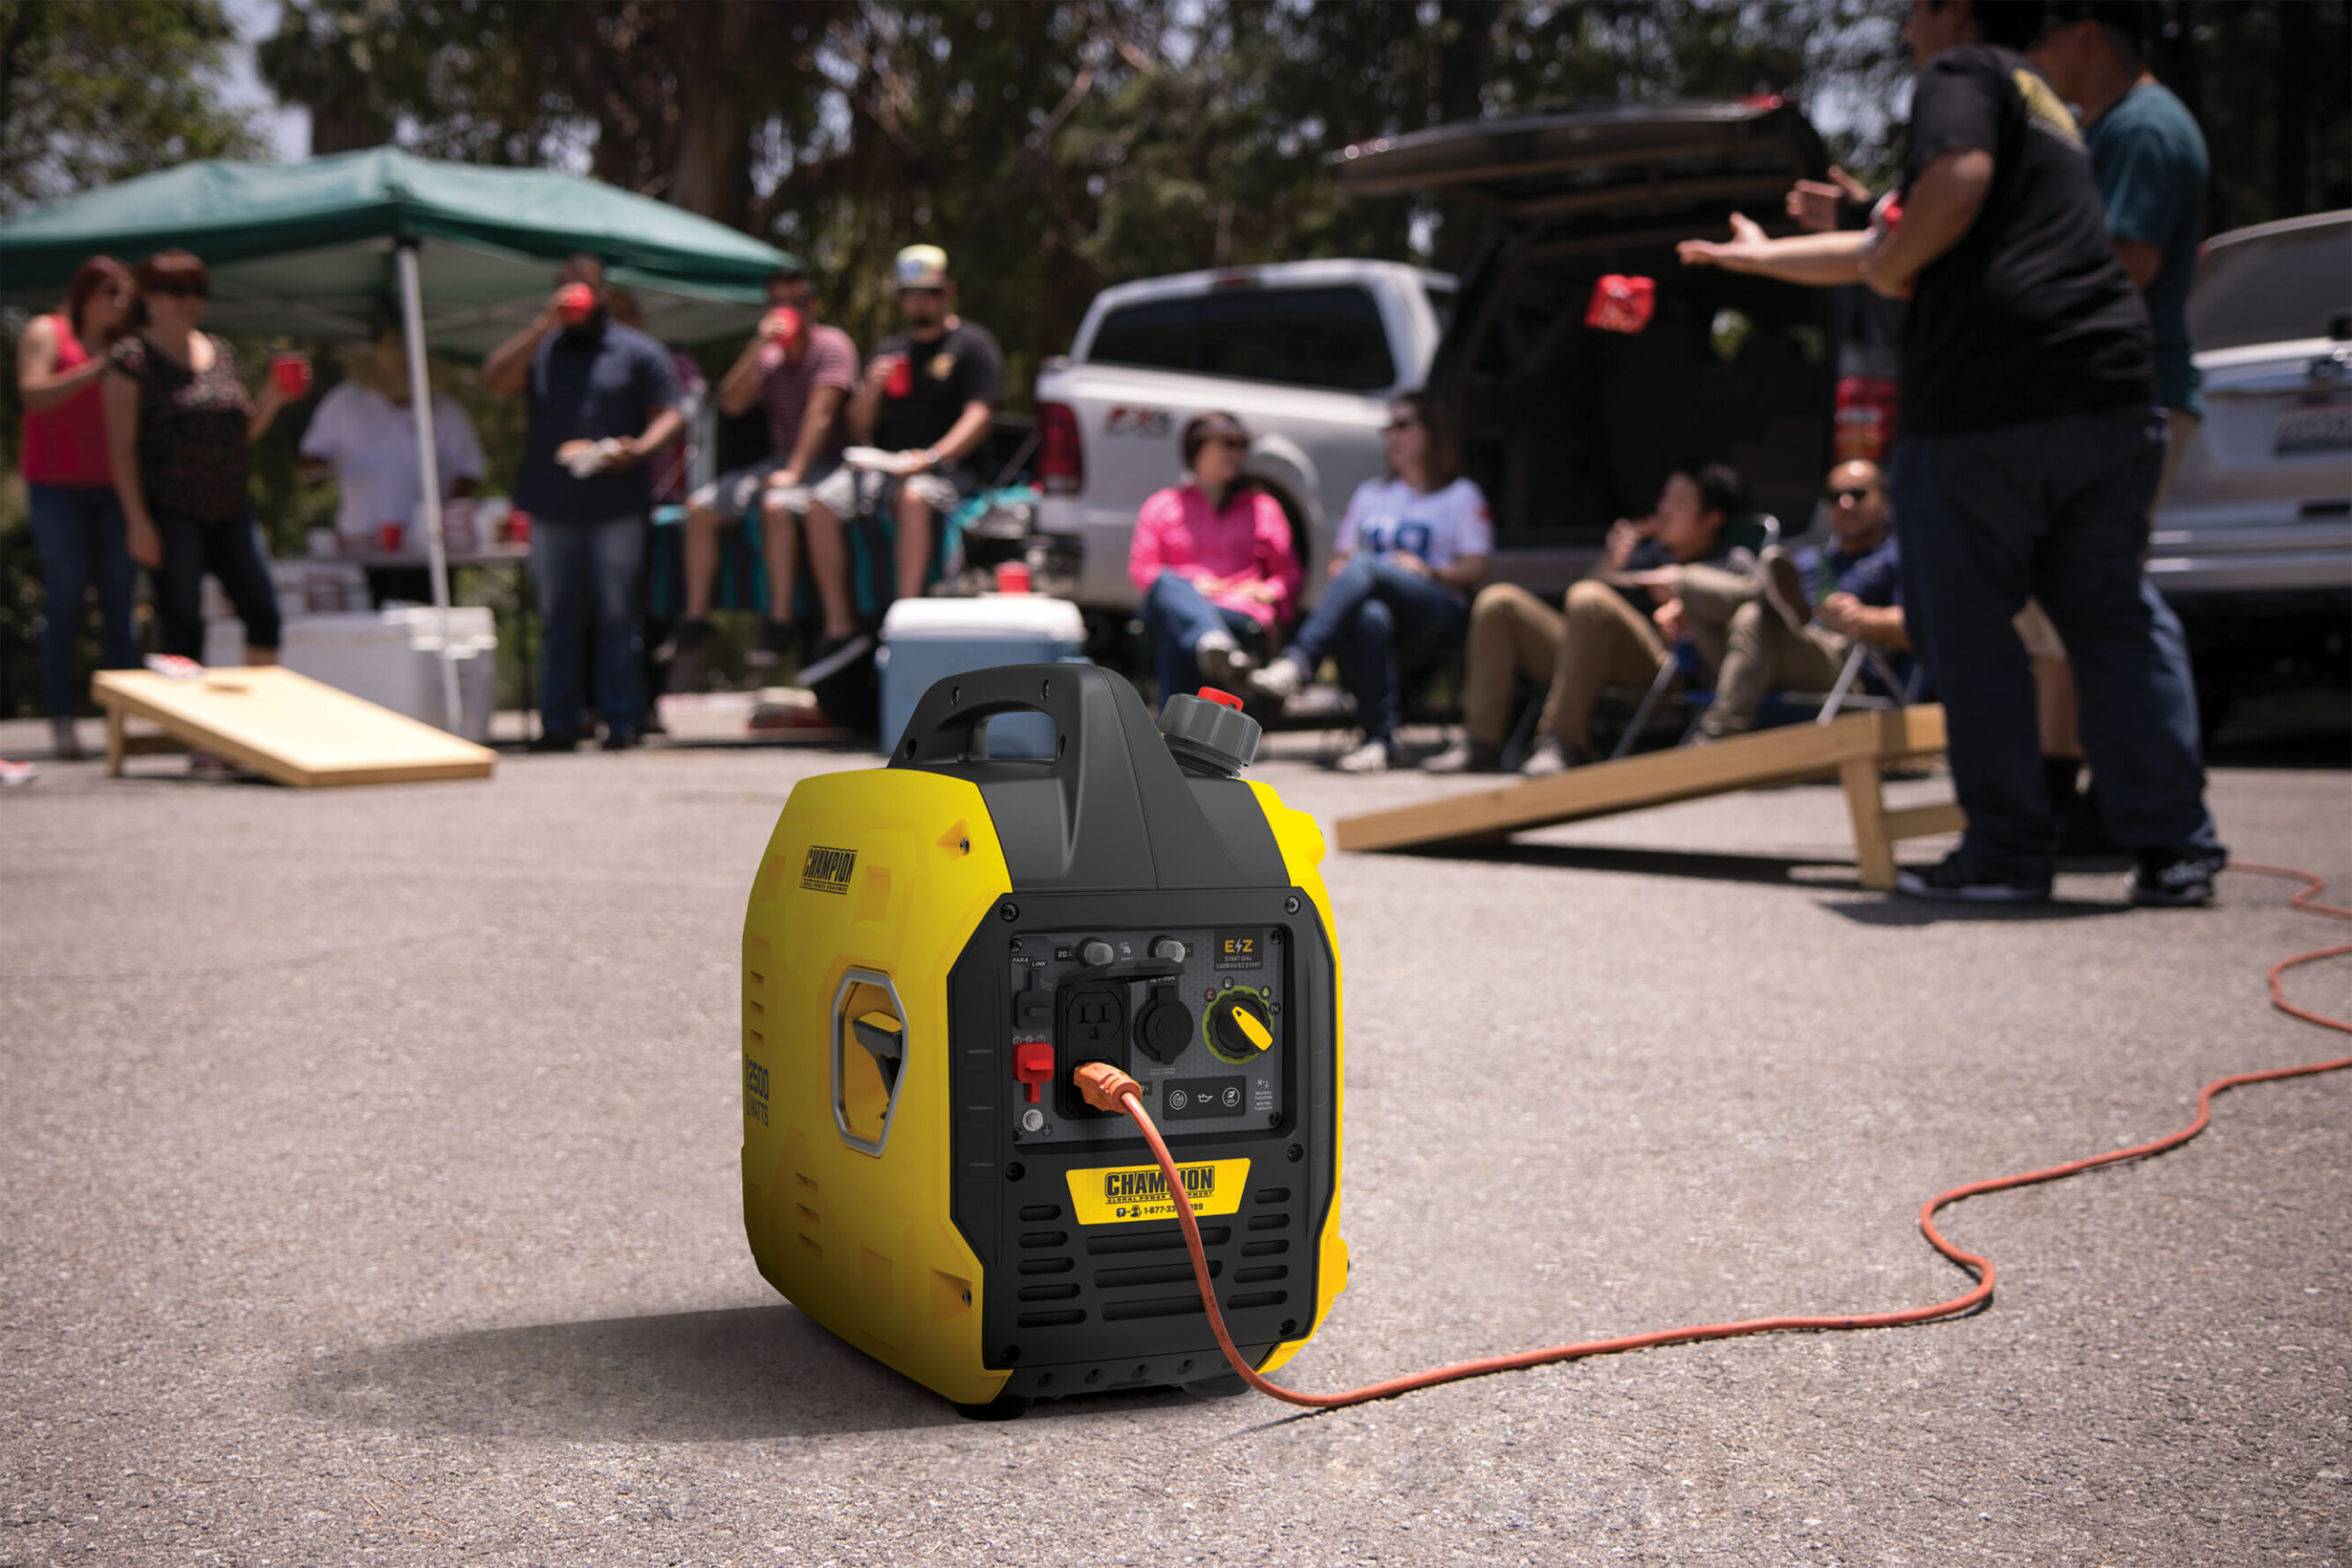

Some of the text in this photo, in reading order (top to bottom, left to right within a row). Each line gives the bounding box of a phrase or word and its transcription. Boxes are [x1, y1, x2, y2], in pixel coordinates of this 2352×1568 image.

[803, 848, 857, 884] CHAMPION
[1107, 1168, 1213, 1196] CHAMION
[1143, 1202, 1203, 1215] 1-877-3399
